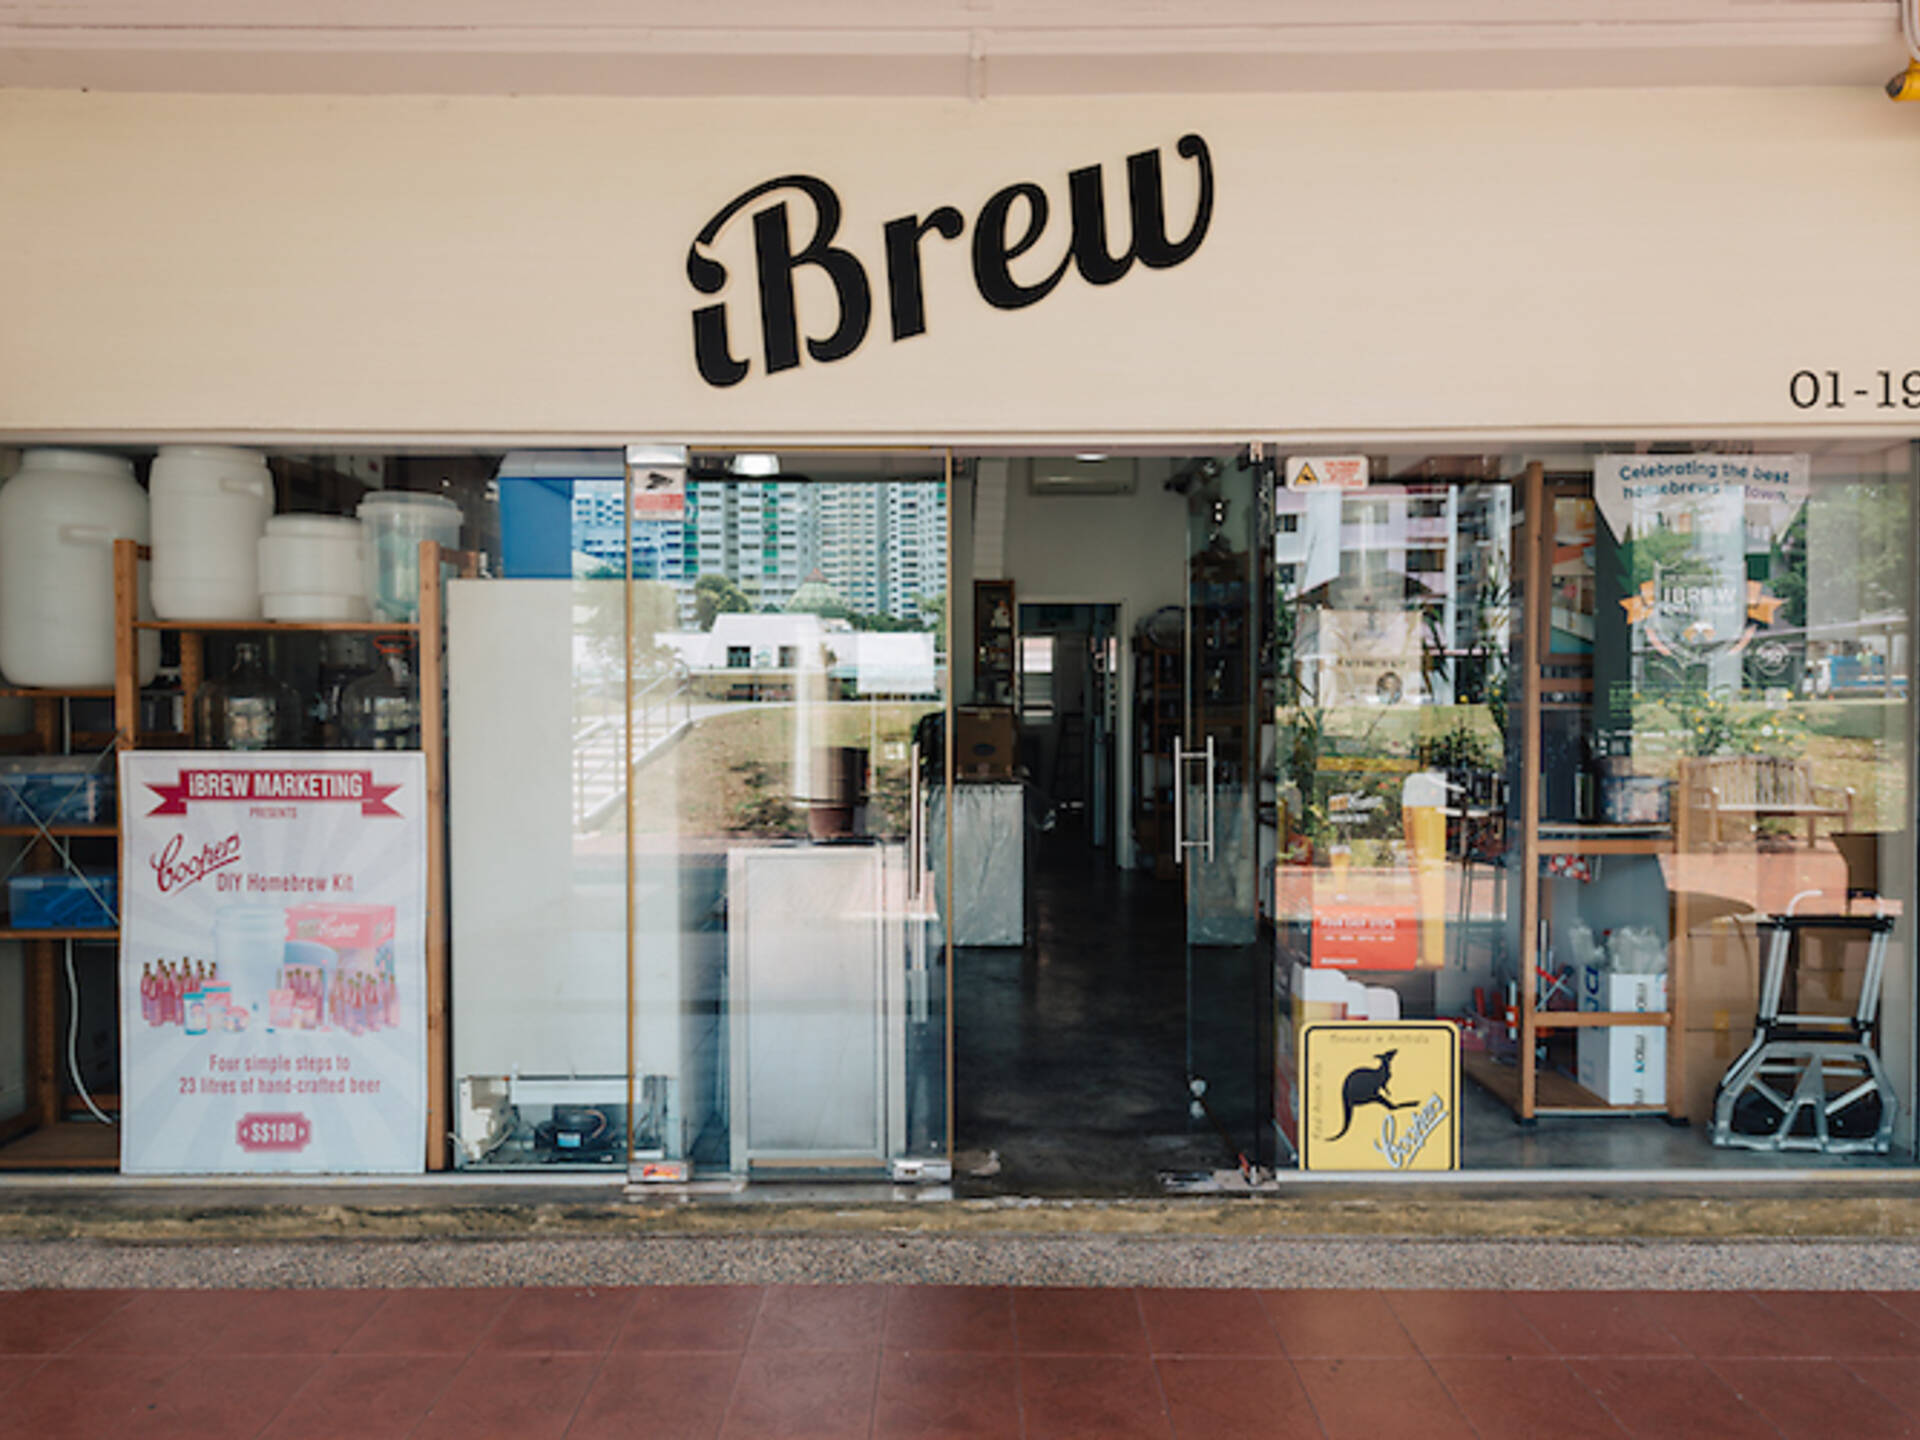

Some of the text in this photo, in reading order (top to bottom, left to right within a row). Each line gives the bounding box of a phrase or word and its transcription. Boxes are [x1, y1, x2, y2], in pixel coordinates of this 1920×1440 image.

[687, 134, 1213, 388] iBrew
[1619, 461, 1789, 484] Celebrating the best
[254, 773, 363, 797] MARKETING
[249, 806, 297, 819] PRESENTS
[216, 873, 354, 893] DIY Homebrew Kit
[209, 1054, 351, 1074] Four simple steps to
[179, 1076, 381, 1094] 23 litres of hand-crafted beer
